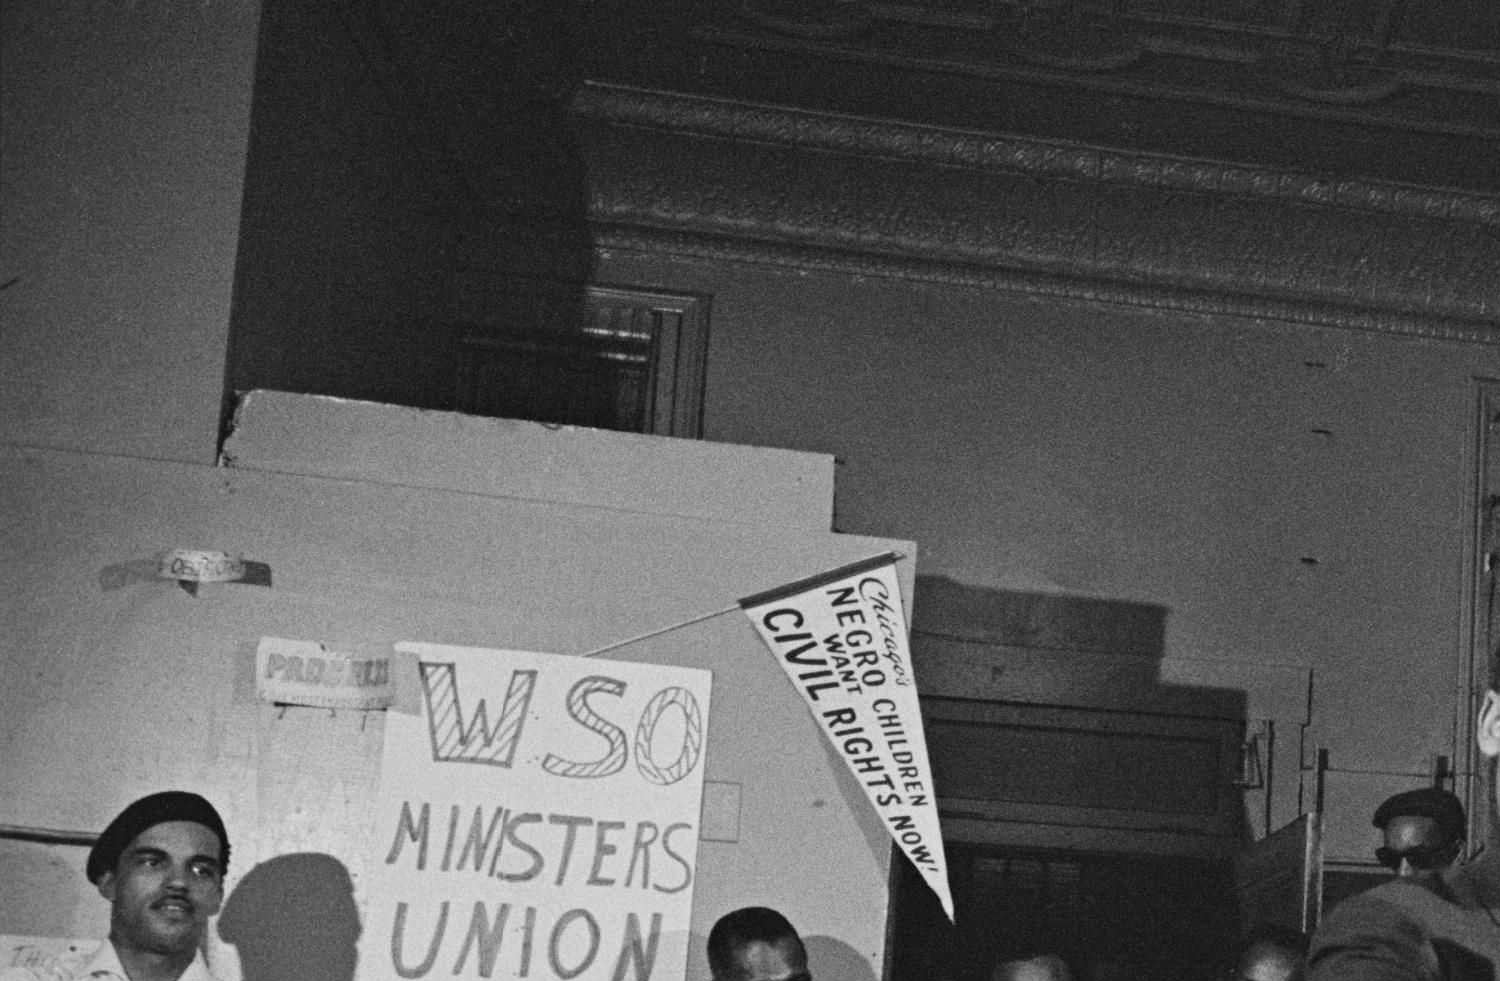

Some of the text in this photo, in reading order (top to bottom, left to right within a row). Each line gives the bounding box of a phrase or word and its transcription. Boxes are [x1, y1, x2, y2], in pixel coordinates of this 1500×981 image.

[823, 633, 863, 695] WANT
[858, 577, 909, 687] Chicago's
[418, 660, 702, 786] WSO
[763, 608, 939, 872] CIVIL RIGHTS NOW!
[826, 586, 928, 807] NEGRO CHILDREN
[384, 800, 692, 894] MINISTERS
